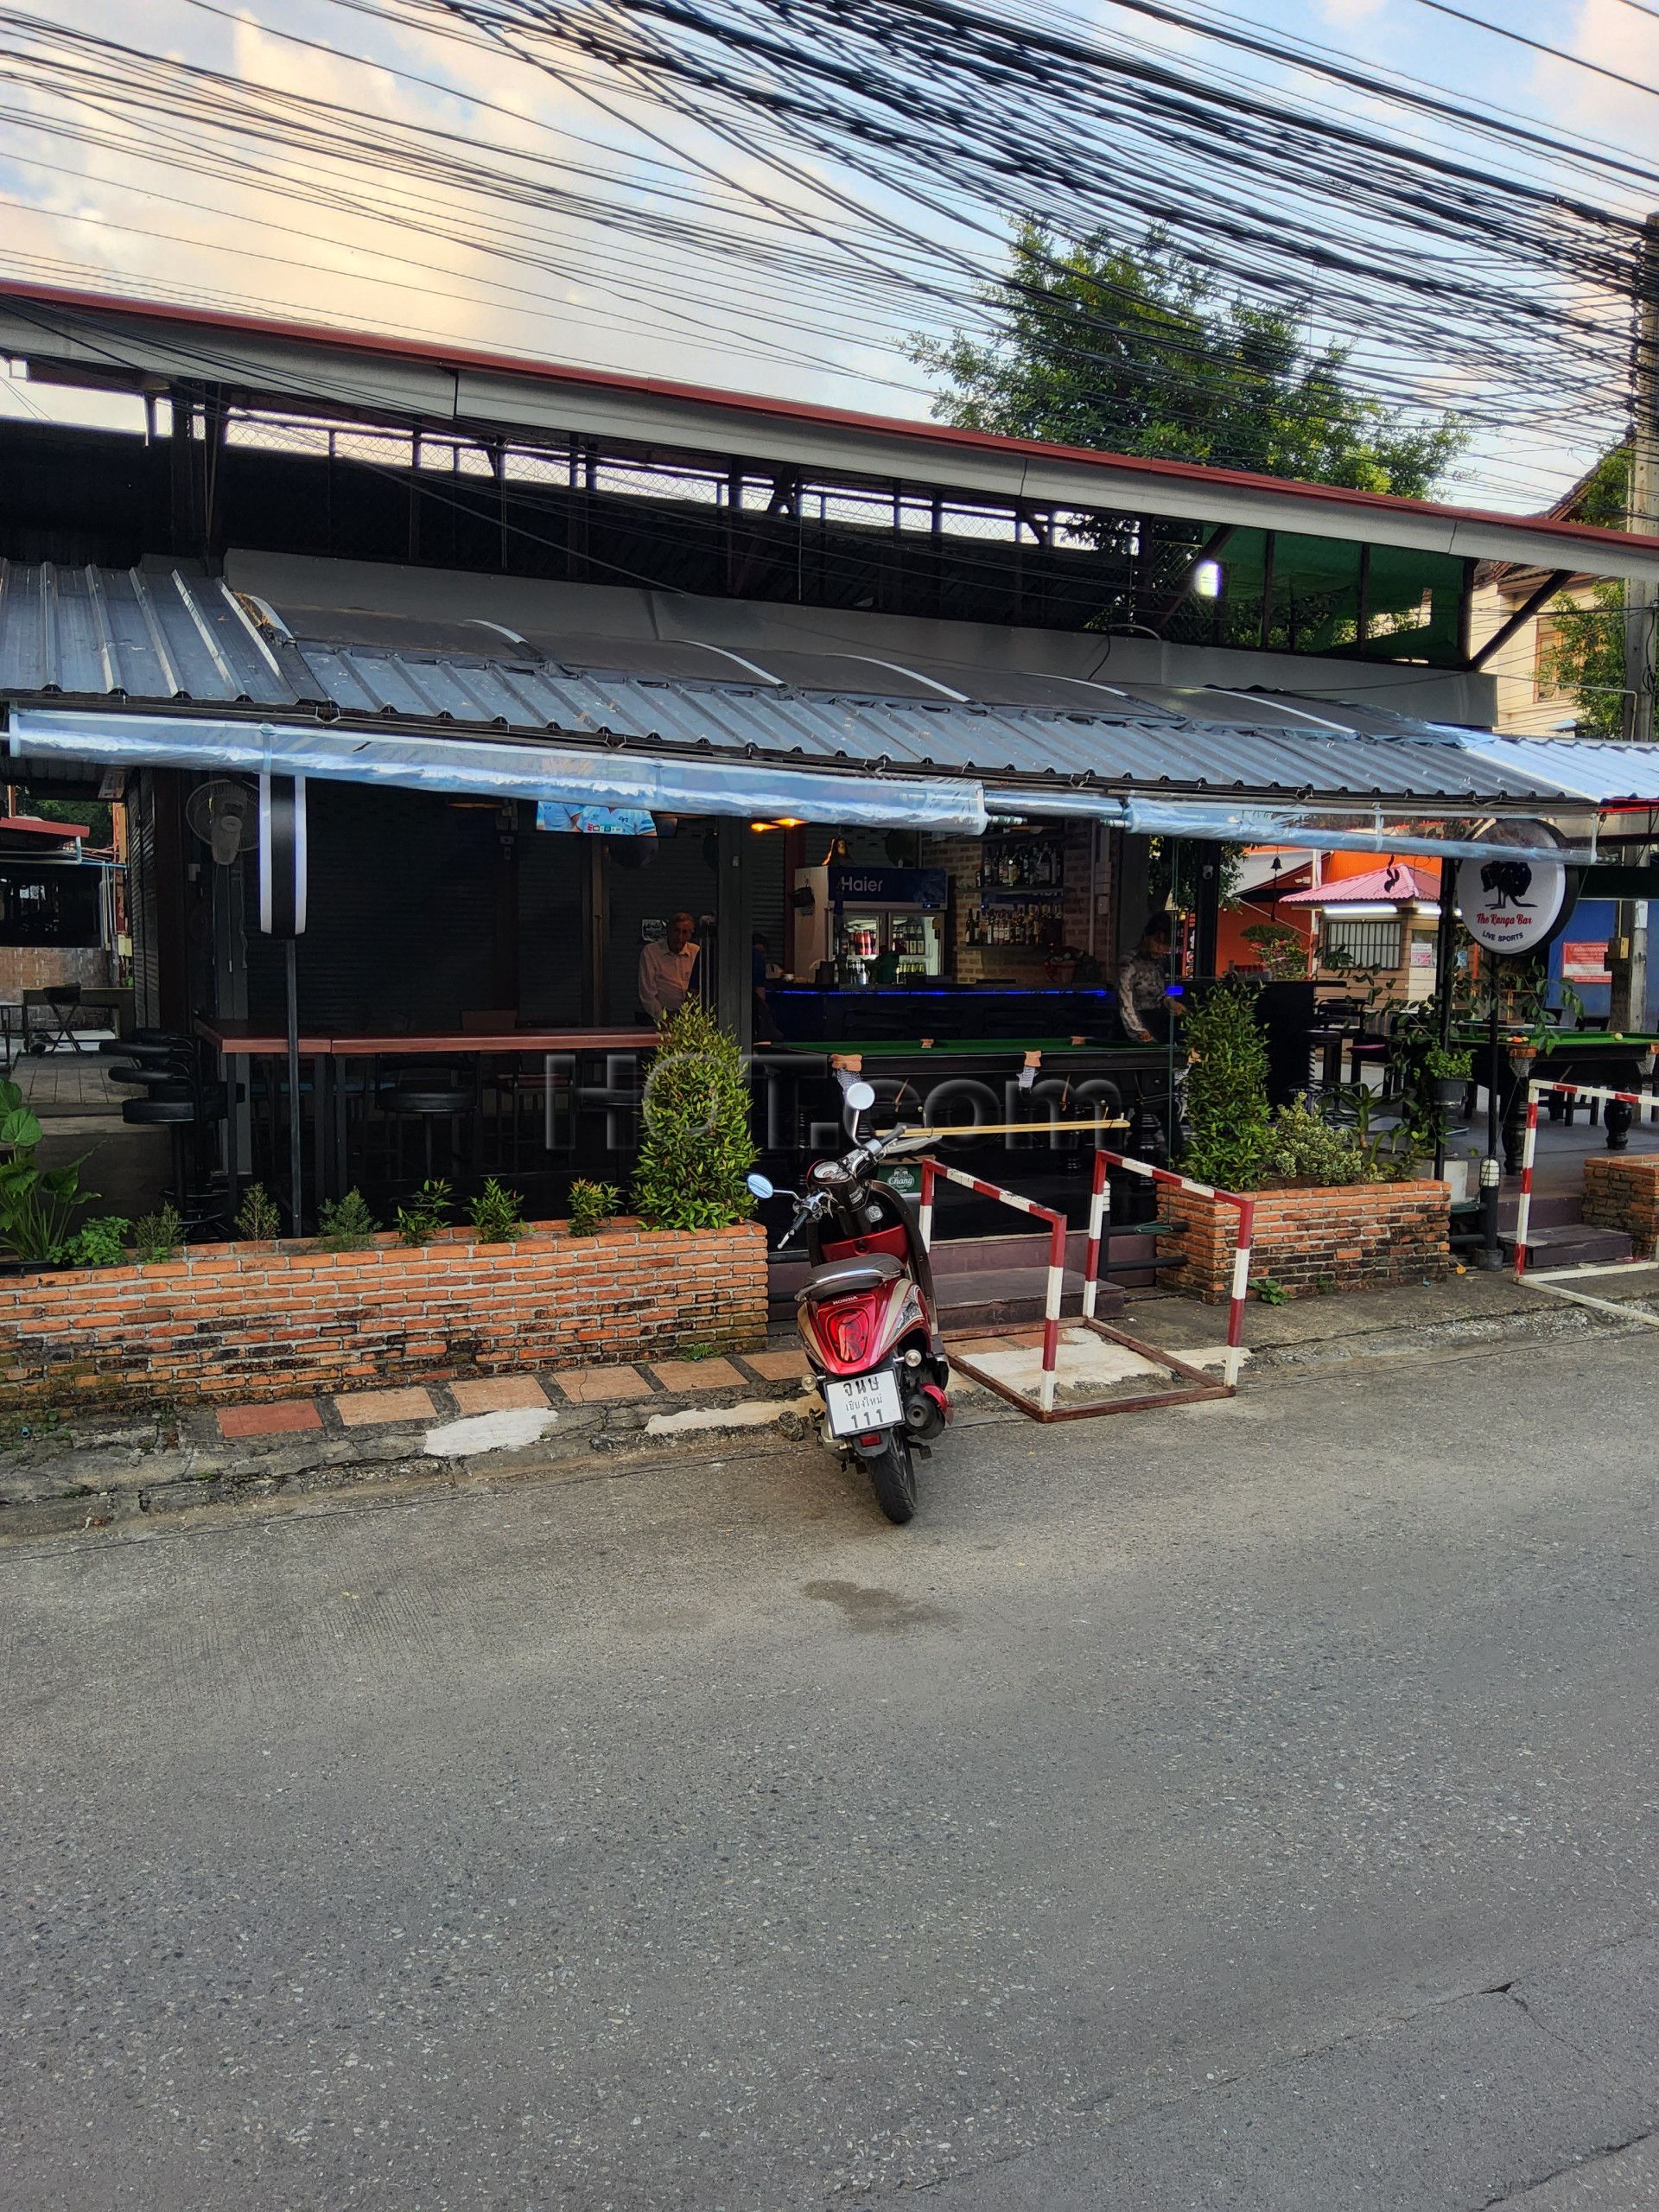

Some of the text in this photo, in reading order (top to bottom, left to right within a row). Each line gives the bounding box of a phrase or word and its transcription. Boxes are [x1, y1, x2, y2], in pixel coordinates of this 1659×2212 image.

[841, 875, 883, 892] Haier
[1477, 913, 1489, 924] The
[1516, 913, 1532, 925] Bar
[1482, 931, 1523, 942] LIVE SPORTS
[888, 1176, 913, 1185] Chang
[832, 1296, 858, 1305] HONDA
[846, 1394, 883, 1411] เชียงใหม่
[851, 1408, 884, 1428] 111
